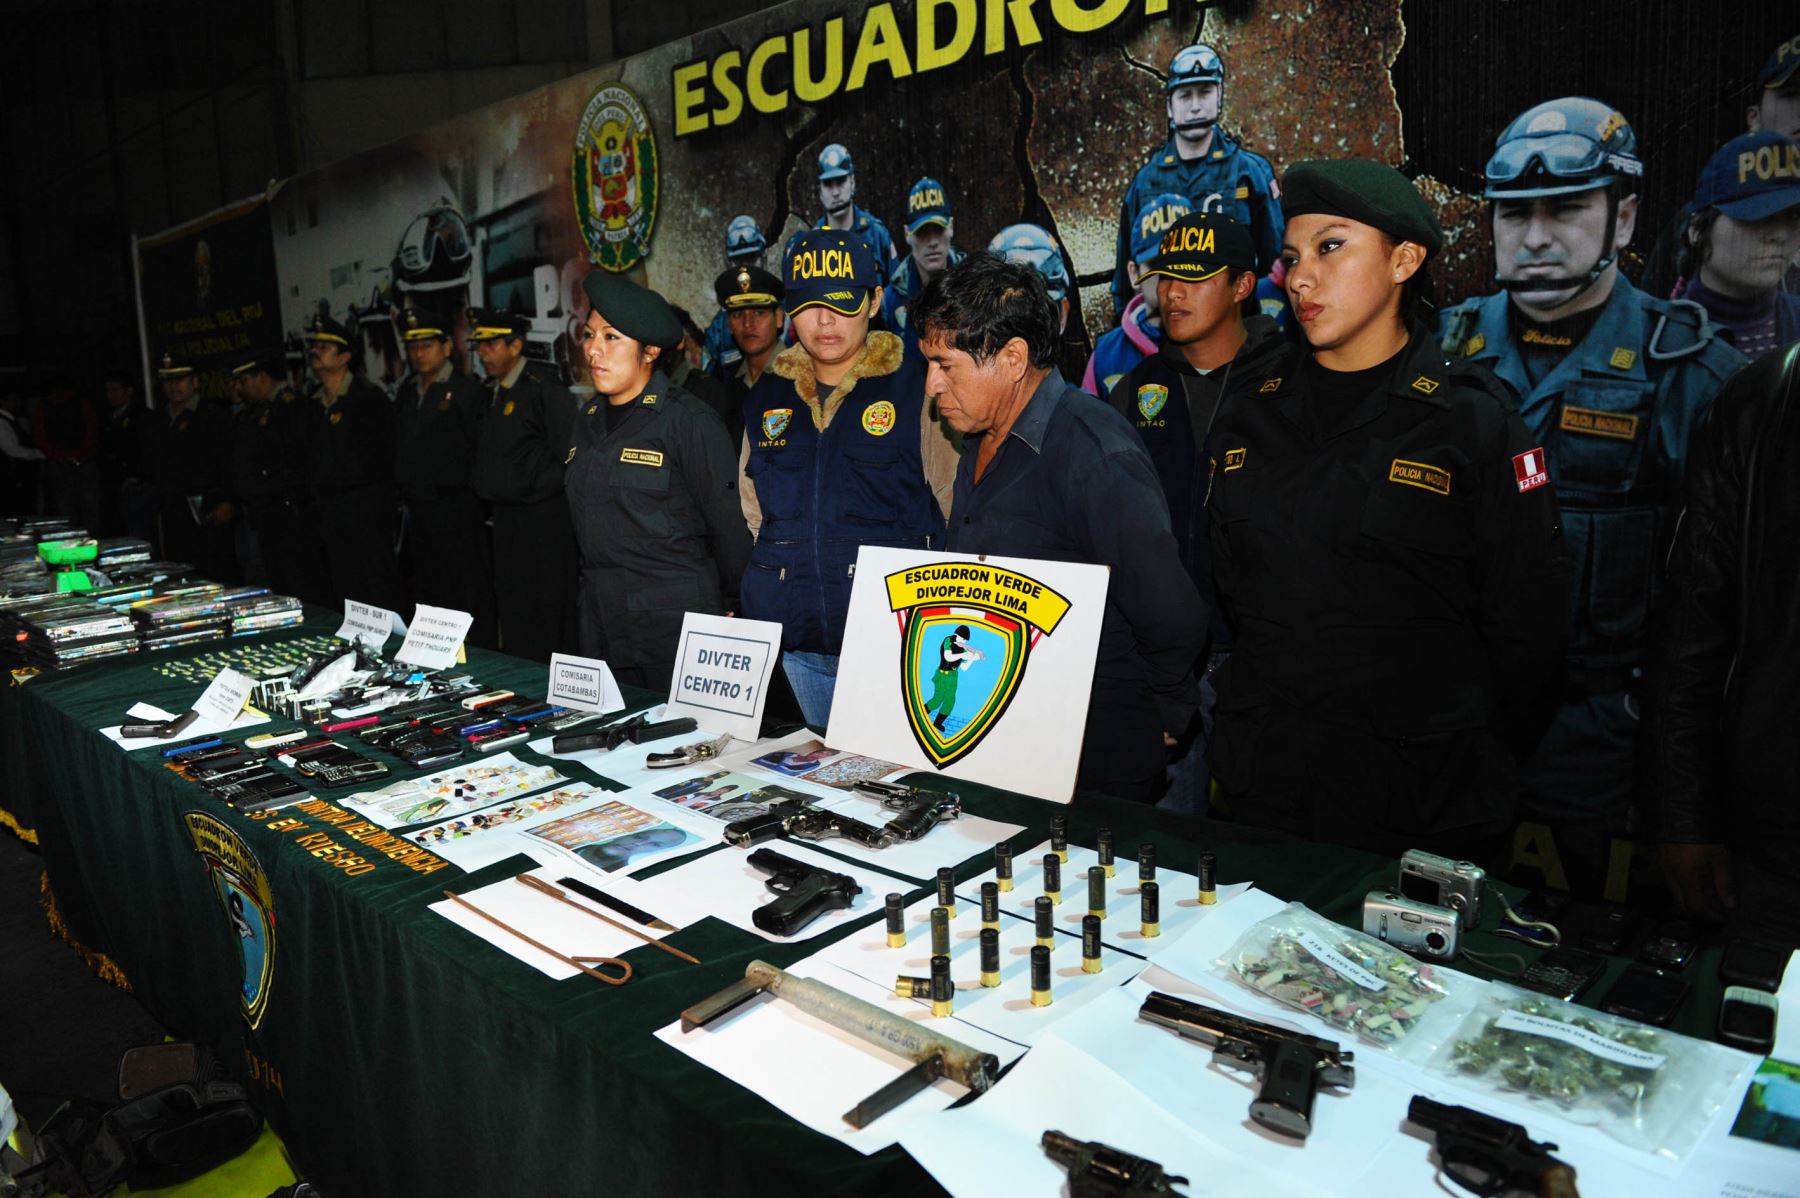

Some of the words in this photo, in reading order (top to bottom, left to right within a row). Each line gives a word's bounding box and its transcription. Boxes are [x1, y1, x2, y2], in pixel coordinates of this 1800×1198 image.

[673, 0, 1203, 138] ESCUADR
[908, 188, 945, 213] POLICIA
[792, 249, 855, 281] POLICIA
[1166, 263, 1205, 272] TERNA
[824, 290, 855, 300] TERNA
[1393, 465, 1422, 480] POLICIA
[1521, 474, 1547, 490] PERU
[905, 568, 990, 584] ESCUADRON
[994, 573, 1042, 599] VERDE
[916, 586, 992, 602] DIVOPEJOR
[994, 592, 1028, 614] LIMA
[412, 628, 444, 641] COMISARIA
[697, 648, 752, 672] DIVTER
[560, 669, 593, 682] COMISARIA
[556, 682, 597, 698] COTABAMBAS
[683, 675, 741, 699] CENTRO
[745, 686, 753, 701] 1
[265, 817, 310, 833] EN
[294, 831, 377, 877] RIESGO
[1574, 1030, 1586, 1039] DE
